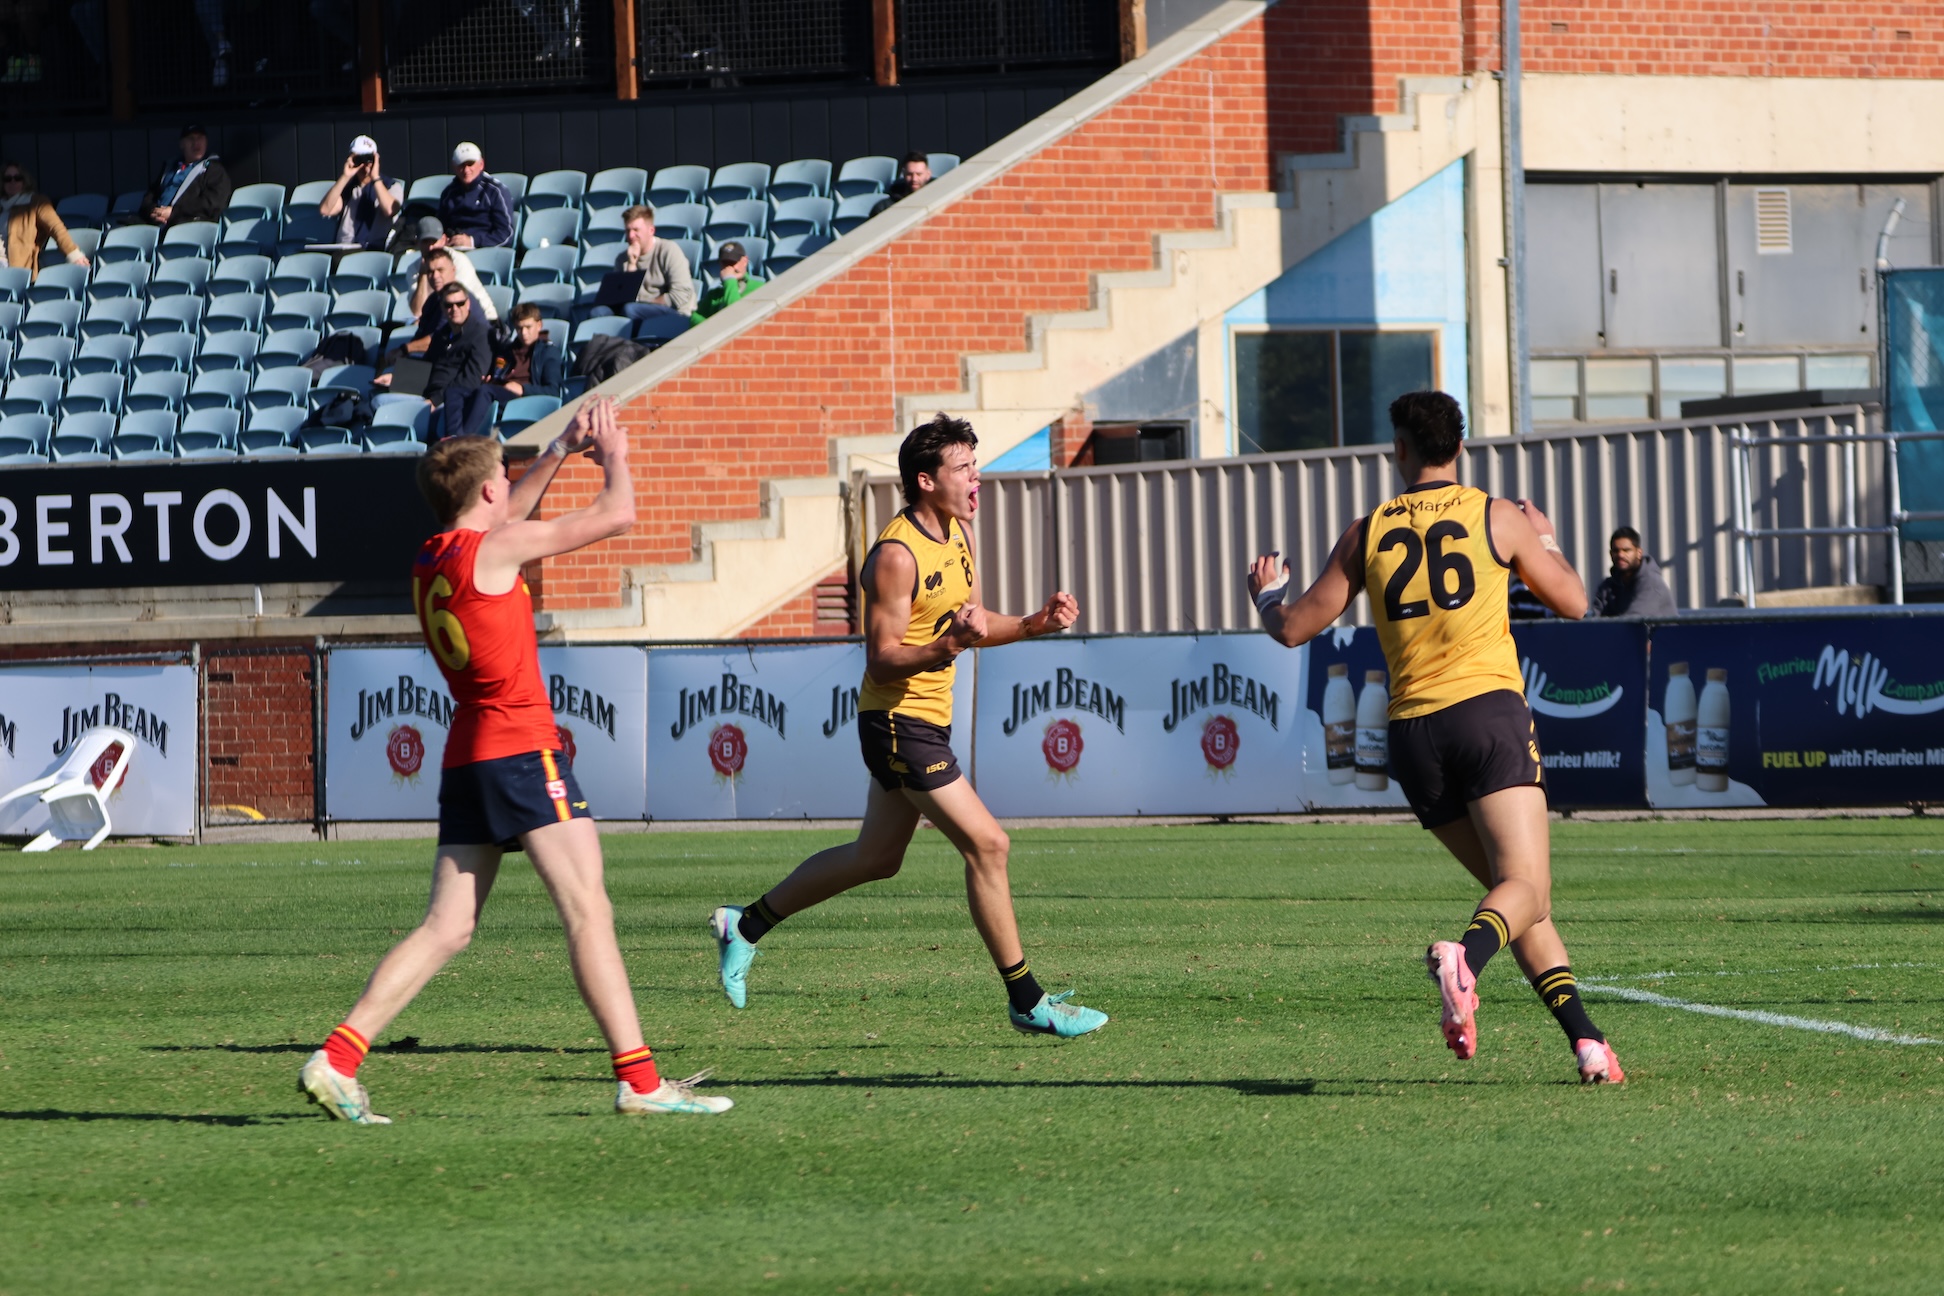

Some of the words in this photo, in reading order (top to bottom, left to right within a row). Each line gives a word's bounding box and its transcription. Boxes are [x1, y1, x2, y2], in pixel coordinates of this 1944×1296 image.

[1378, 520, 1475, 621] 26
[926, 586, 947, 600] Marsh
[1003, 680, 1051, 736] JIM
[1055, 667, 1127, 735] BEAM
[1163, 675, 1209, 733] JIM
[1212, 663, 1280, 732] BEAM
[1544, 681, 1612, 708] Company
[1757, 657, 1816, 684] Fleurieu
[1813, 644, 1888, 719] Milk
[1884, 678, 1944, 704] Compan
[53, 705, 101, 758] JIM
[104, 692, 169, 759] BEAM
[350, 688, 394, 742] JIM
[549, 673, 619, 742] BEAM
[671, 684, 717, 741] JIM
[720, 673, 787, 741] BEAM
[400, 743, 411, 759] B
[723, 741, 733, 758] B
[1057, 737, 1068, 754] B
[1215, 733, 1225, 750] B
[1583, 750, 1621, 768] Milk!
[1763, 752, 1803, 768] FUEL
[1804, 751, 1827, 768] UP
[1829, 749, 1863, 767] with
[1863, 748, 1924, 767] Fleurieu
